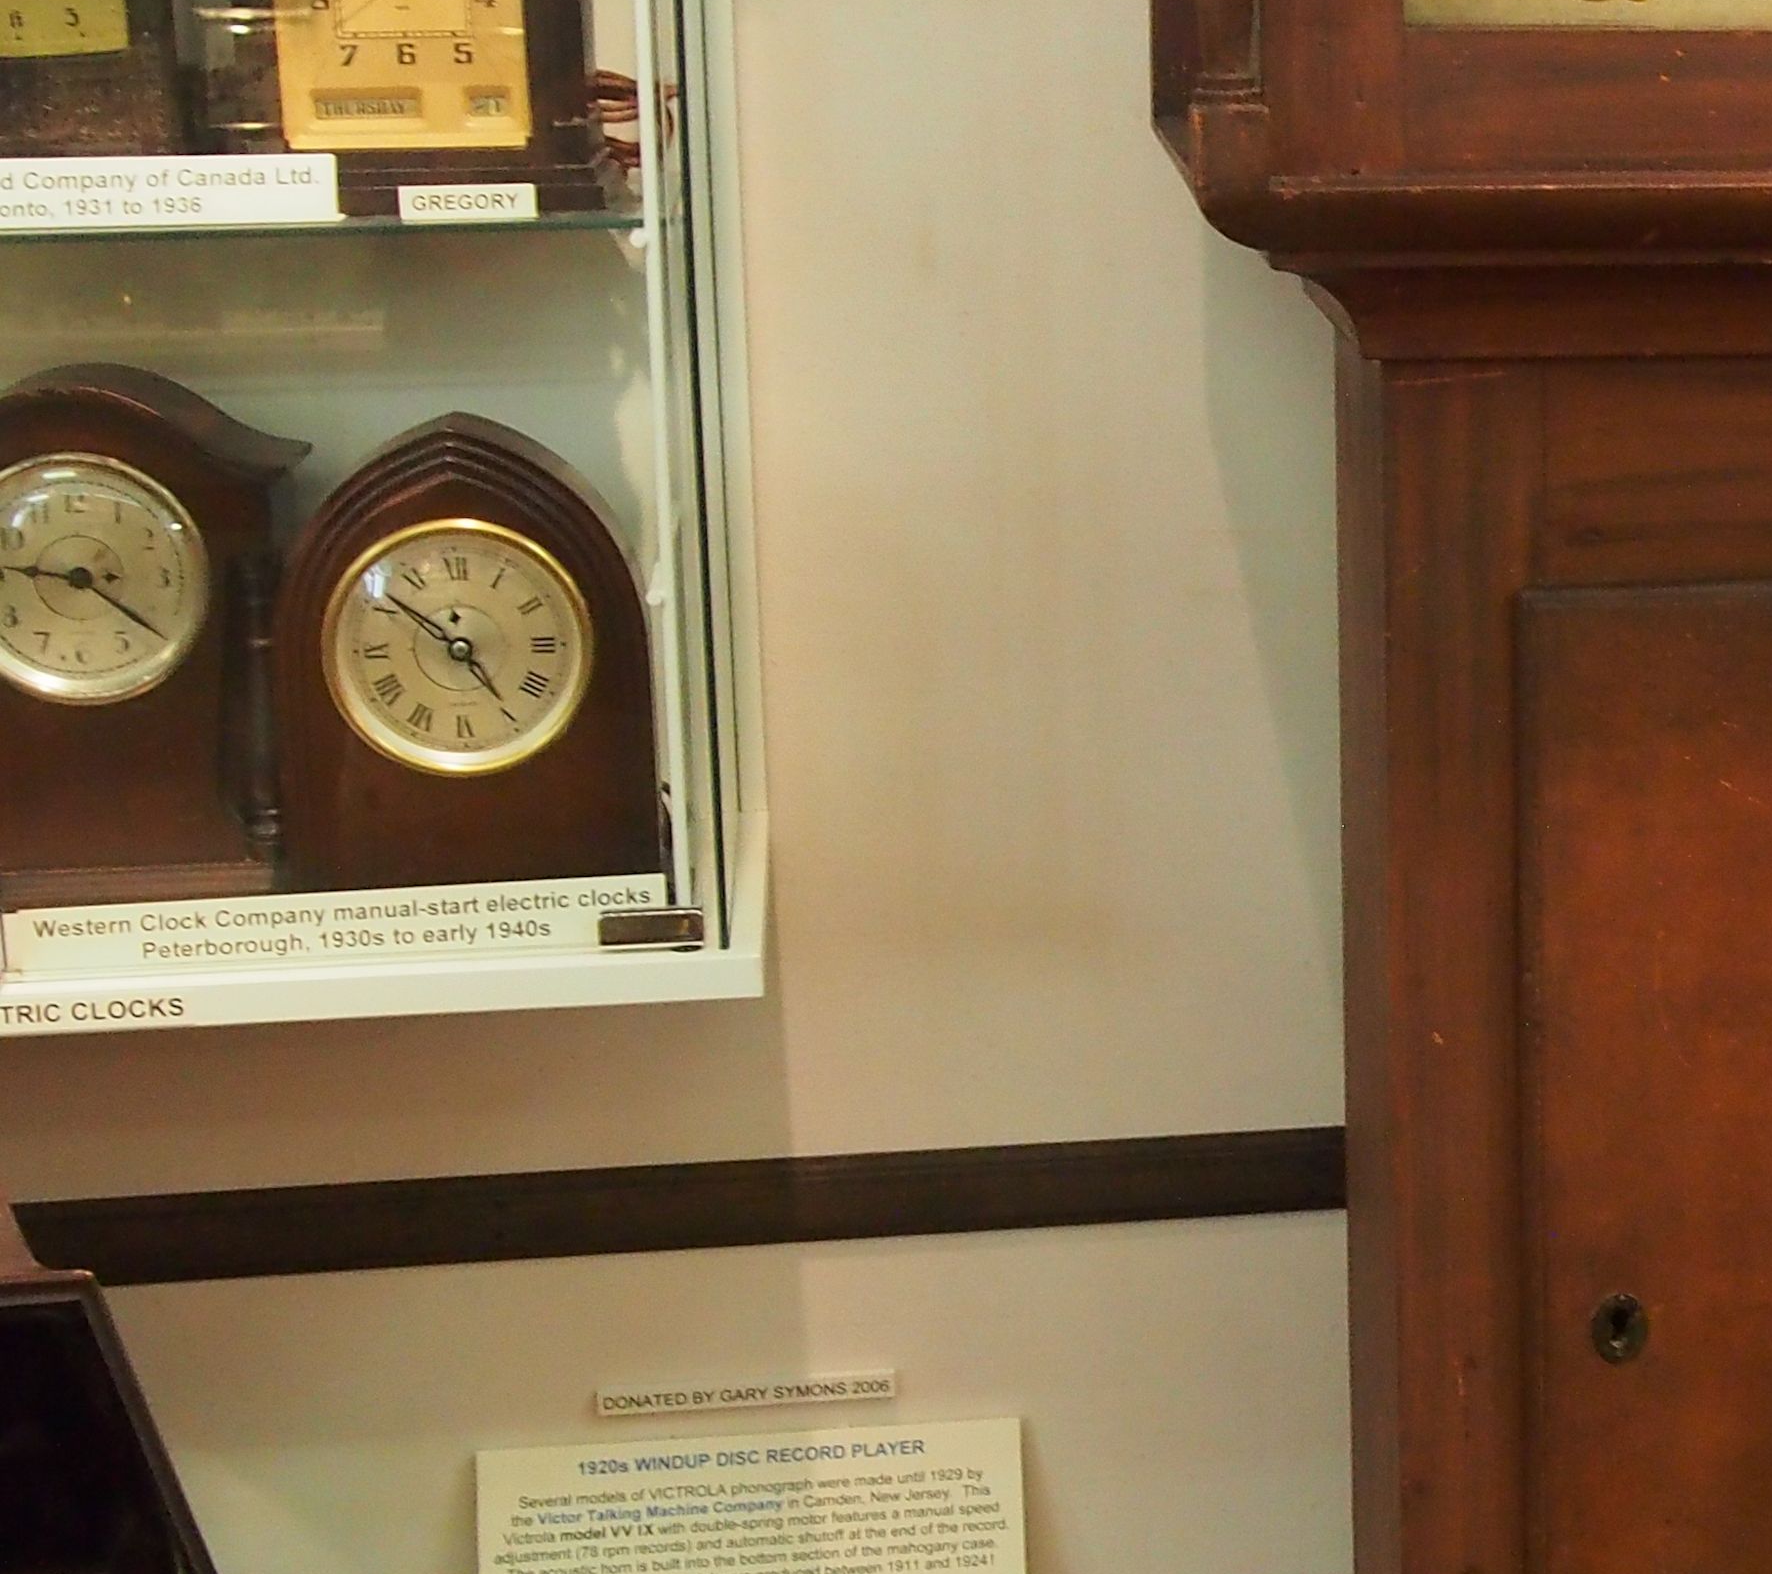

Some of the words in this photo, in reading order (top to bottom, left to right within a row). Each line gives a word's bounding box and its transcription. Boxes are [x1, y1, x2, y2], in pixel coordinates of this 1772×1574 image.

[340, 44, 358, 66] 7
[397, 43, 416, 65] 6
[454, 43, 473, 65] 5
[23, 170, 137, 193] Company
[146, 168, 169, 187] of
[177, 168, 266, 186] Canada
[276, 167, 319, 184] Ltd.
[65, 198, 112, 215] 1931
[122, 200, 143, 214] to
[153, 196, 202, 213] 1936
[412, 193, 518, 210] GREGORY
[33, 920, 131, 936] Western
[140, 912, 207, 931] Clock
[215, 908, 325, 930] Company
[334, 899, 479, 919] manual-start
[486, 892, 570, 911] electric
[578, 888, 652, 907] clocks
[142, 935, 310, 957] Peterborough,
[319, 929, 385, 947] 1930s
[393, 928, 415, 944] to
[422, 924, 478, 944] early
[486, 919, 552, 938] 1940s
[71, 998, 184, 1020] CLOCKS
[603, 1392, 688, 1409] DONATED
[692, 1390, 715, 1404] BY
[719, 1387, 769, 1402] GARY
[773, 1382, 848, 1398] SYMONS
[852, 1379, 891, 1394] 2006
[578, 1459, 630, 1474] 1920s
[634, 1453, 712, 1470] WINDUP
[716, 1450, 760, 1466] DISC
[766, 1445, 846, 1462] RECORD
[851, 1439, 925, 1457] PLAYER
[518, 1494, 573, 1508] Several
[576, 1491, 628, 1504] models
[630, 1488, 646, 1501] of
[648, 1484, 728, 1499] VICTROLA
[730, 1478, 814, 1496] phonograph
[817, 1478, 851, 1488] were
[854, 1473, 894, 1486] made
[897, 1470, 926, 1484] until
[930, 1468, 962, 1482] 1929
[966, 1467, 984, 1485] by
